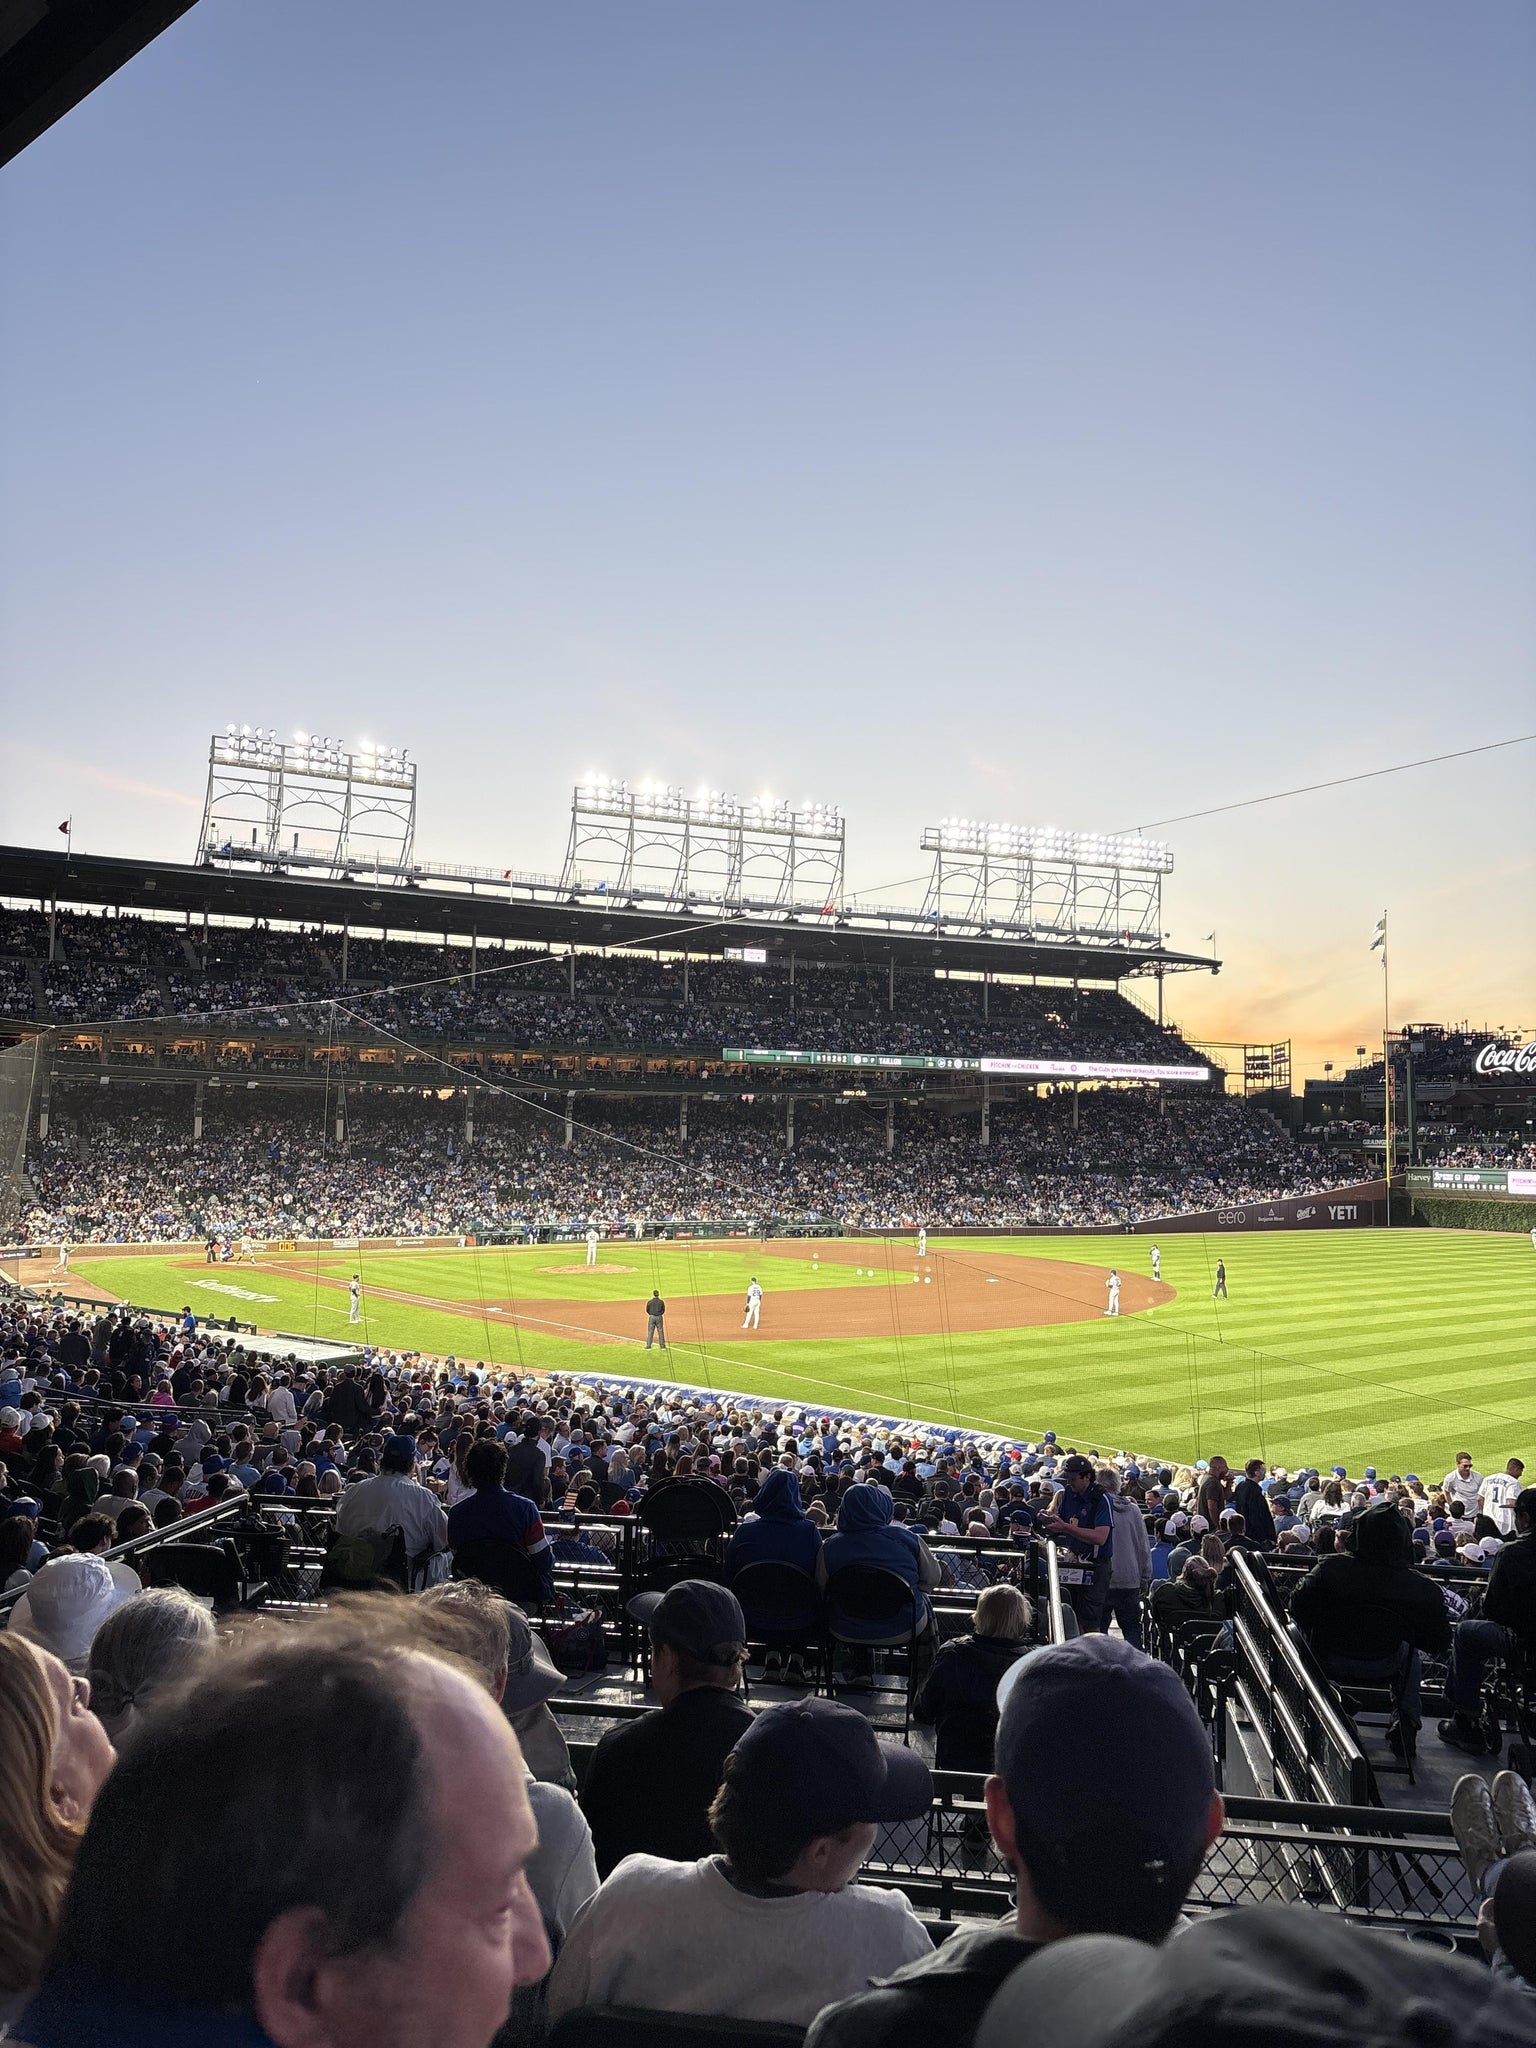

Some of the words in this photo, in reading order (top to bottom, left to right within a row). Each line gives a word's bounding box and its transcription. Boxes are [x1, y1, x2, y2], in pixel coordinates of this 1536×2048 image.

[1407, 1173, 1431, 1182] Harvey
[1218, 1211, 1246, 1225] eero
[1327, 1205, 1357, 1221] YETI
[278, 1241, 296, 1251] 006
[1492, 1486, 1499, 1503] 1
